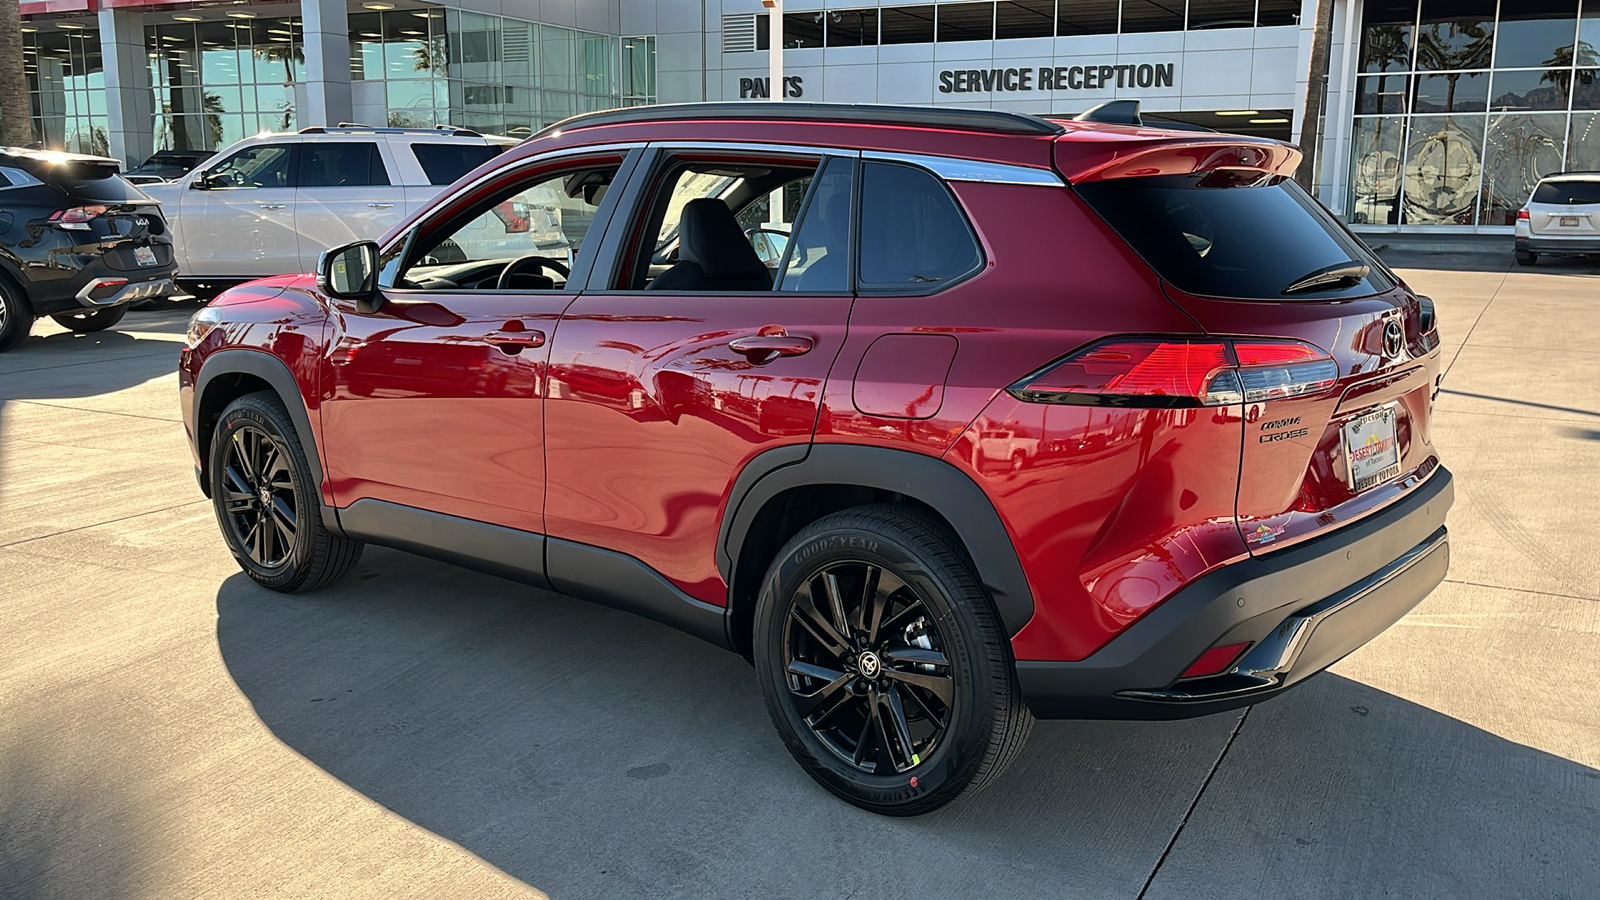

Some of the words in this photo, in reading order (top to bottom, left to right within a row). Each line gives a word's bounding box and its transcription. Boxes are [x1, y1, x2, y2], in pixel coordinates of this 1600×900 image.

[939, 68, 1032, 93] SERVICE
[1038, 63, 1174, 90] RECEPTION
[1259, 427, 1308, 443] CROSS
[1351, 445, 1373, 462] DESERT
[1356, 474, 1378, 491] DESERT
[1379, 465, 1400, 481] TOYOTA
[794, 536, 879, 565] GOODYEAR
